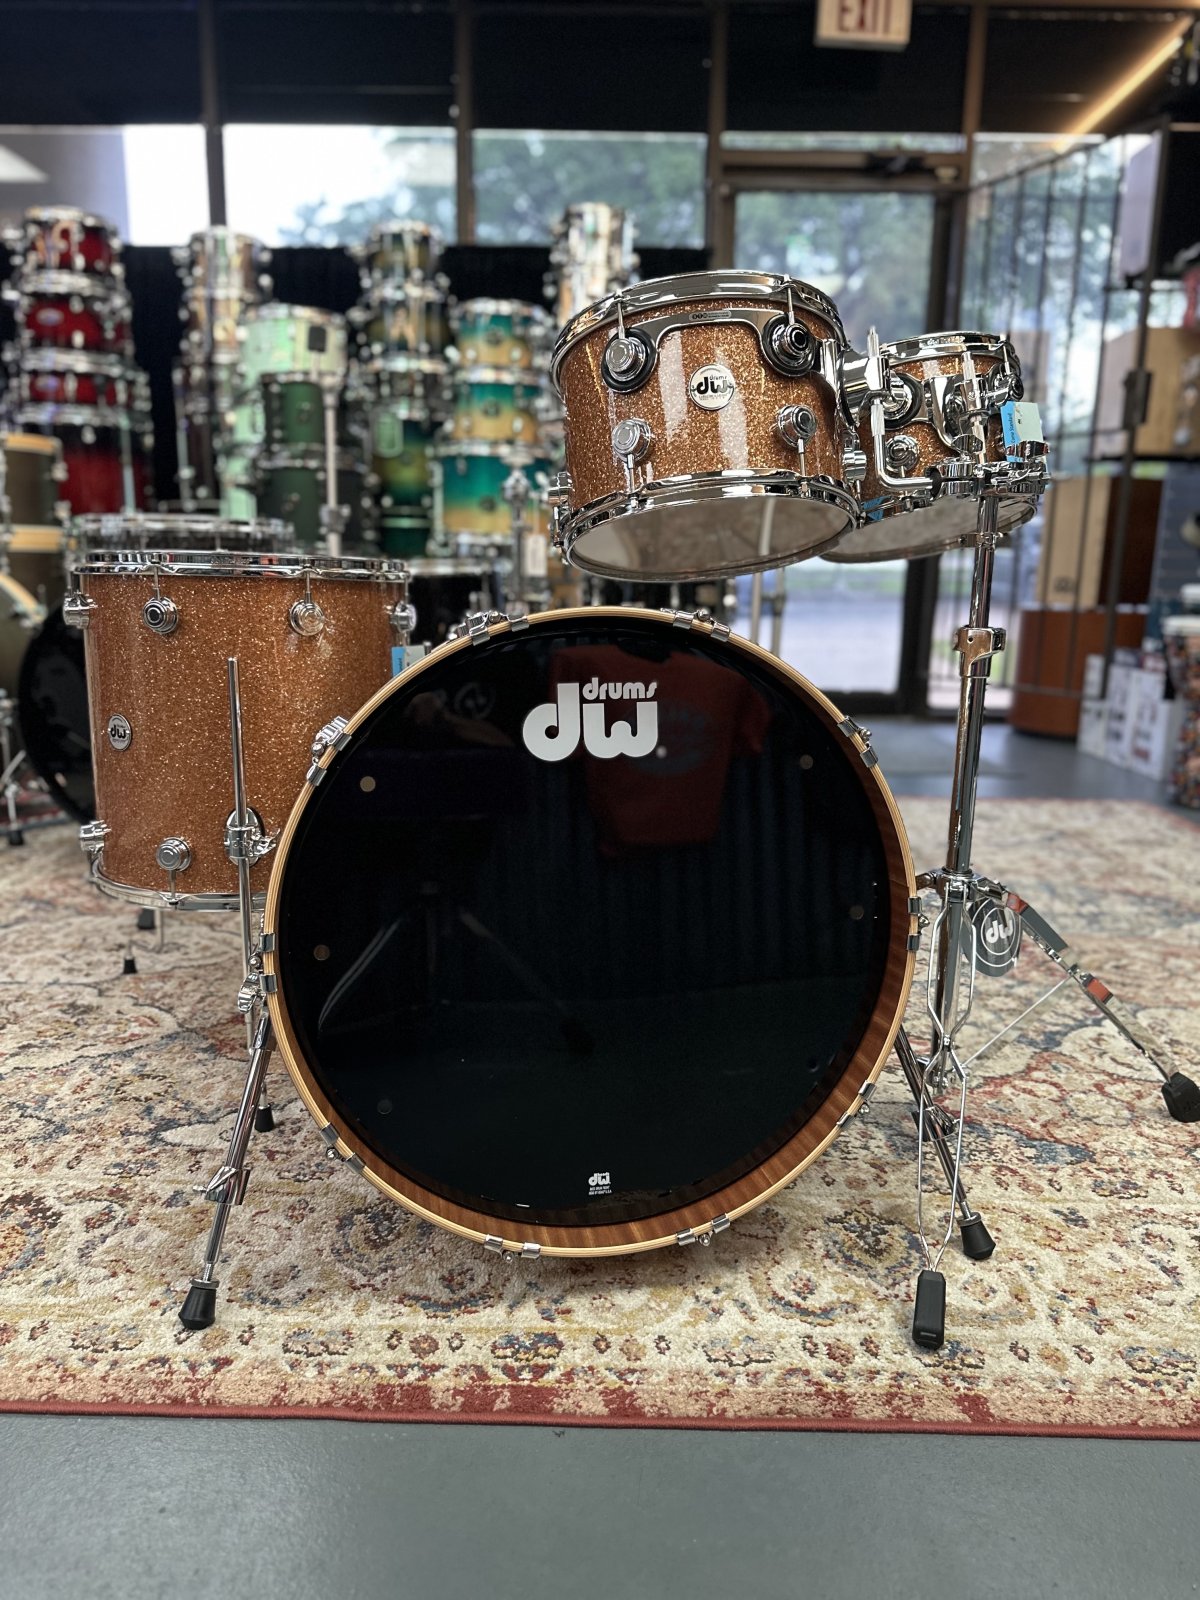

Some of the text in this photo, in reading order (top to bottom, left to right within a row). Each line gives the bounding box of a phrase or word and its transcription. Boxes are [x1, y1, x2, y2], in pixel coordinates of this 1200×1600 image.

[696, 377, 728, 395] dw
[582, 677, 658, 700] drums
[523, 683, 659, 761] dw
[110, 725, 126, 739] dw
[588, 1172, 610, 1186] dw
